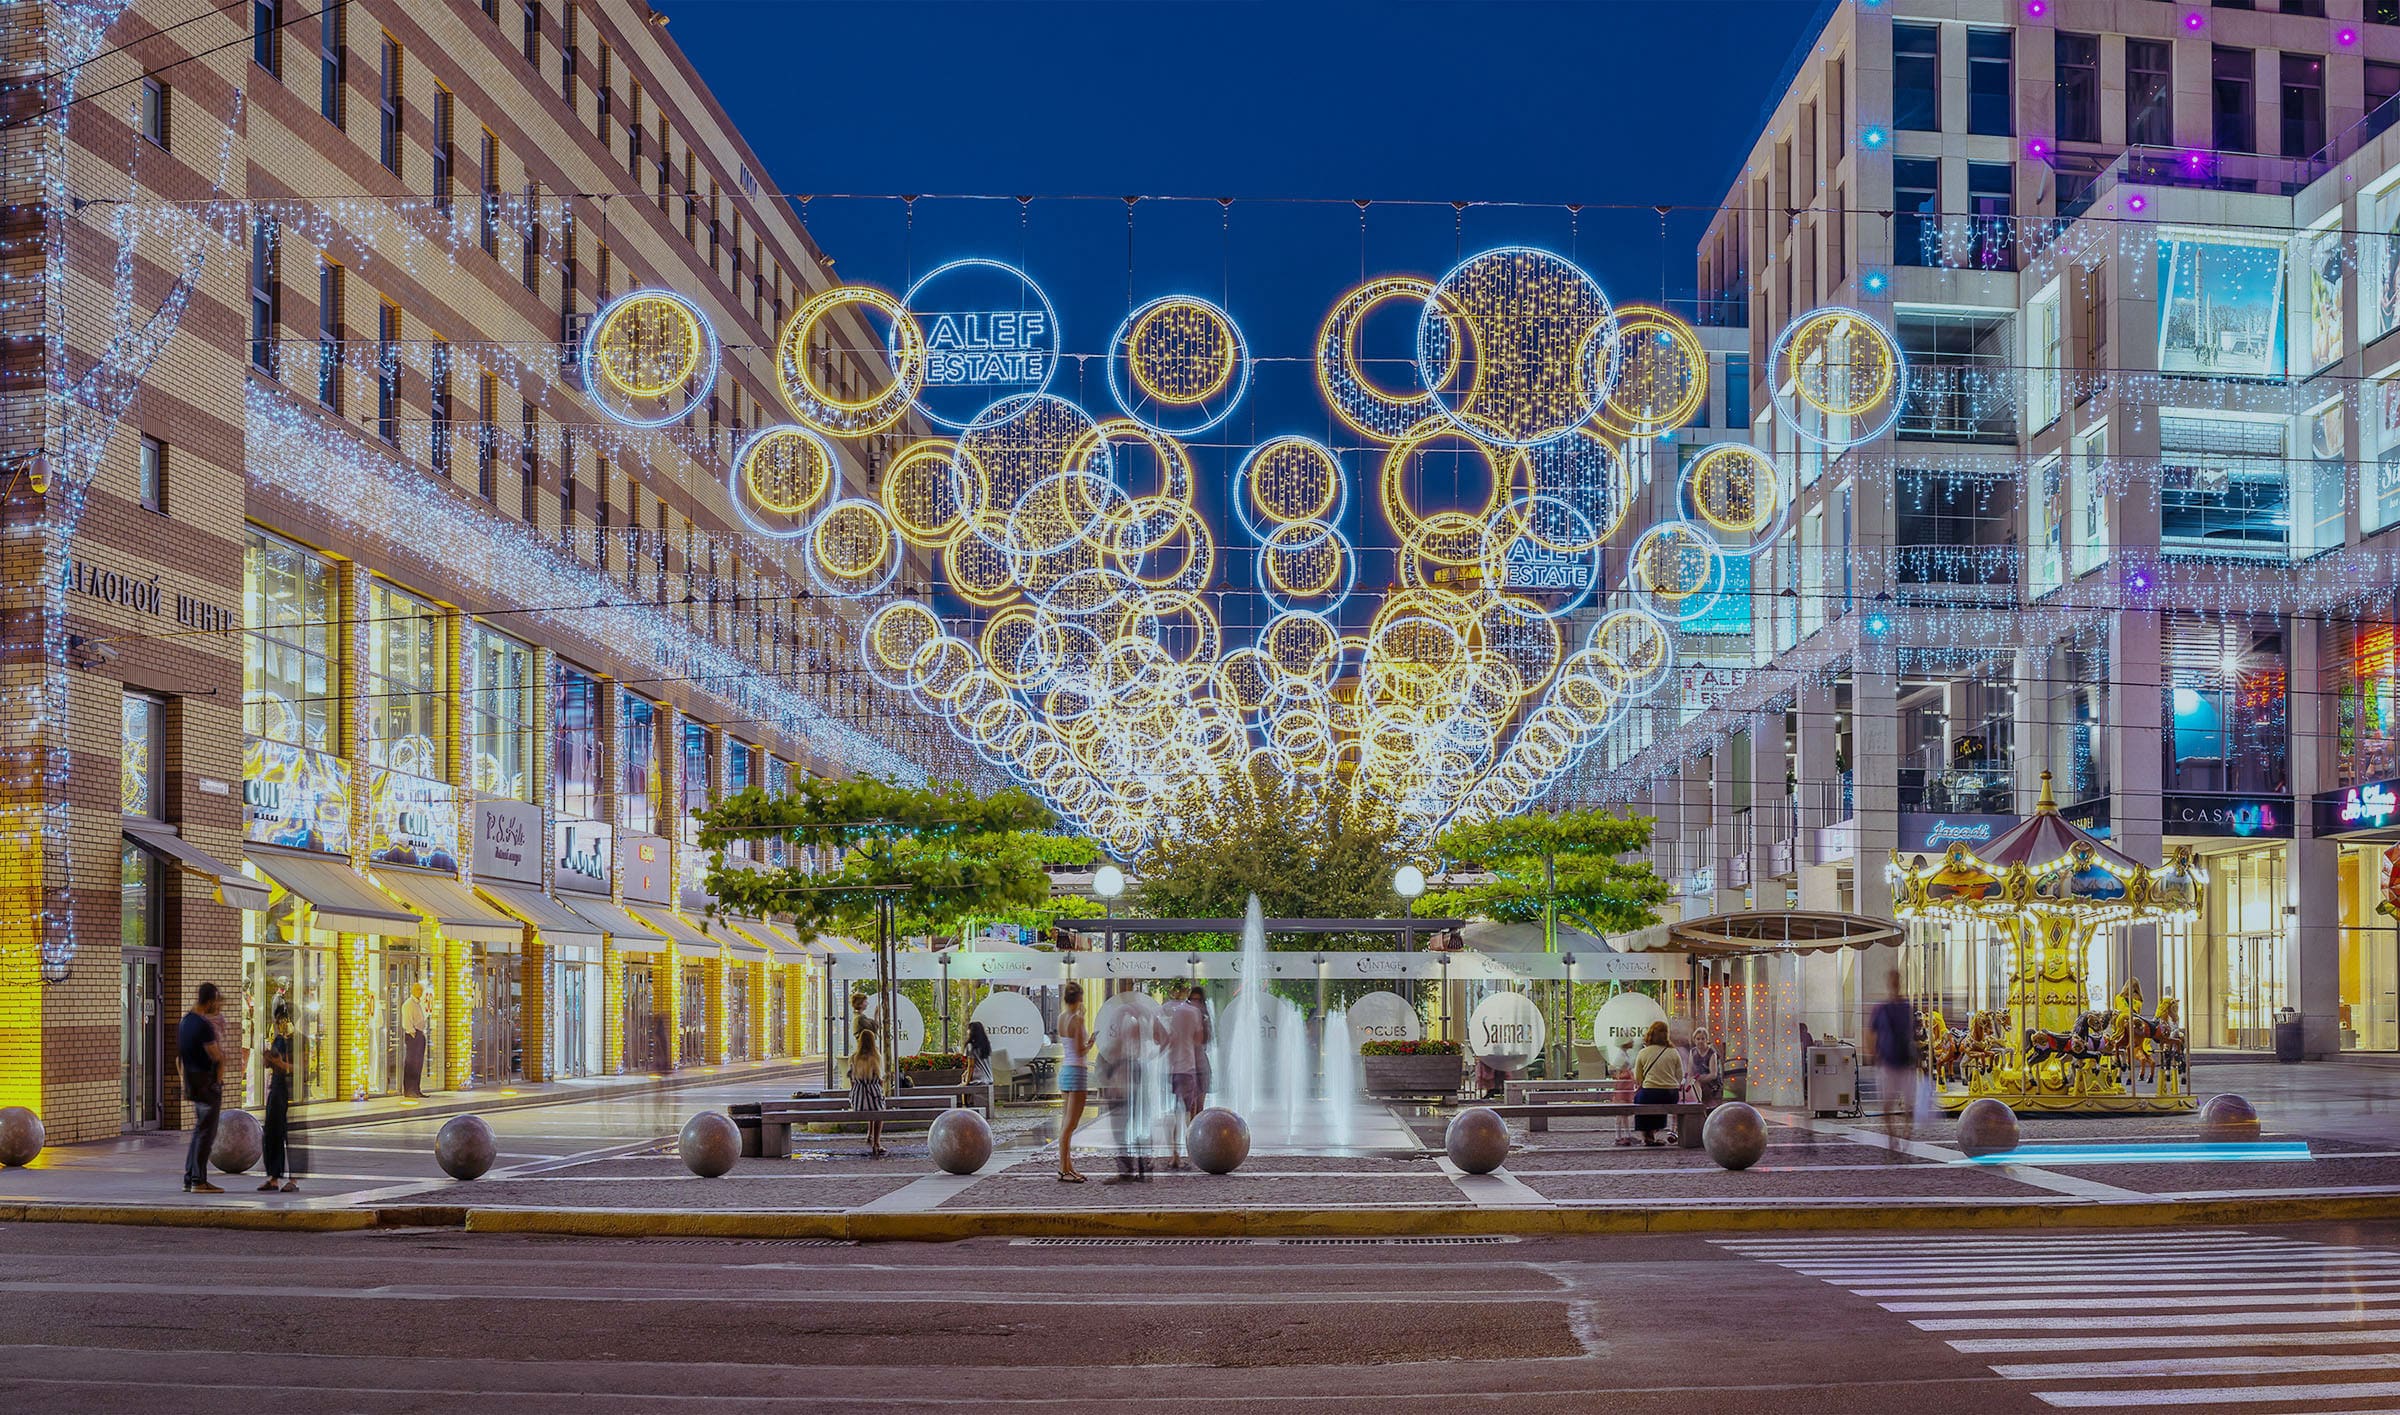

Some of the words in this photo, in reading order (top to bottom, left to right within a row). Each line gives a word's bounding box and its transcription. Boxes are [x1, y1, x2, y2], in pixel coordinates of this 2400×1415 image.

[926, 313, 1044, 350] ALEF
[925, 353, 1043, 382] ESTATE
[1506, 536, 1588, 563] ALEF
[1505, 564, 1588, 588] ESTATE
[63, 558, 162, 616] ДЕЛОВОЙ
[178, 593, 235, 637] ЦЕНТР
[2182, 807, 2272, 824] CASADI
[1926, 819, 1990, 848] jacadi
[1357, 1025, 1407, 1037] OGUES
